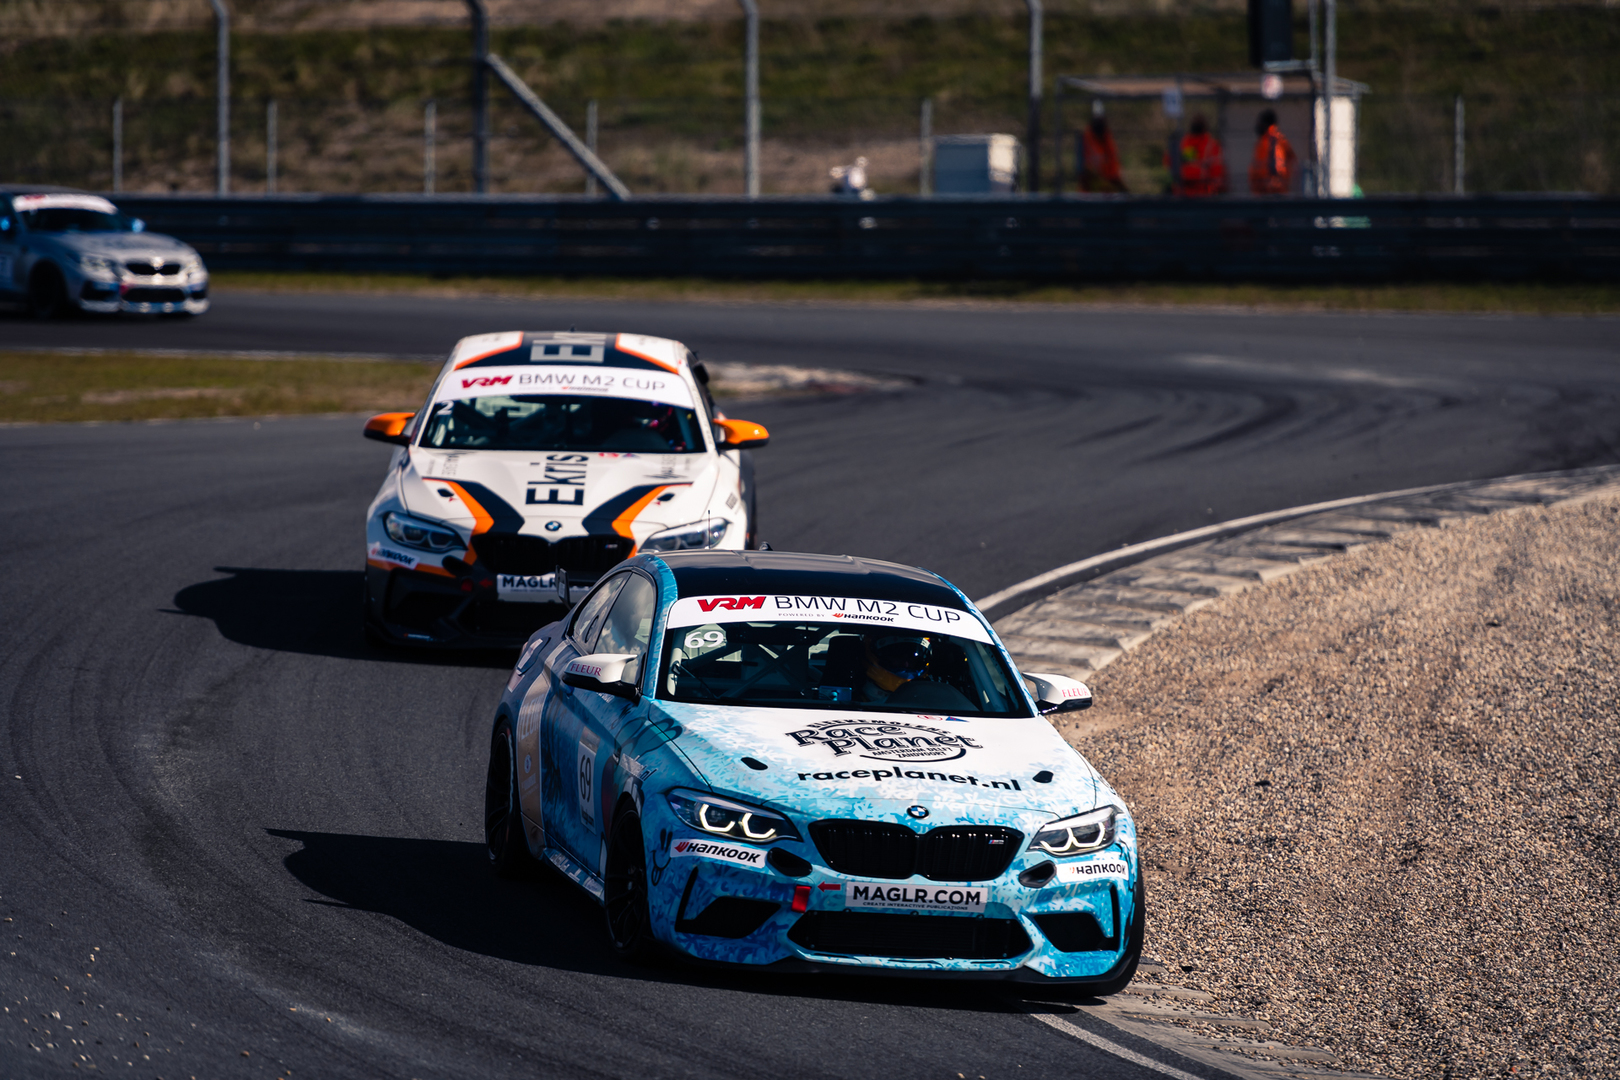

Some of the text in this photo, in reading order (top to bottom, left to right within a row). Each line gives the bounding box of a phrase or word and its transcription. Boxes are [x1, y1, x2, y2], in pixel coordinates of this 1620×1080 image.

[461, 375, 513, 388] VRM
[519, 373, 575, 385] BMW
[582, 375, 615, 387] M2
[622, 377, 666, 391] CUP
[437, 400, 455, 416] 2
[525, 454, 589, 506] Ekris
[697, 596, 961, 624] VRM BMW M2 CUP
[684, 631, 725, 649] 69
[570, 663, 602, 677] FLEUR
[1061, 687, 1089, 698] FLEUR
[785, 726, 906, 747] Race
[822, 735, 984, 757] Planet
[579, 754, 592, 803] 69
[797, 766, 1022, 791] raceplanet.nl
[853, 885, 981, 906] MAGLR.COM
